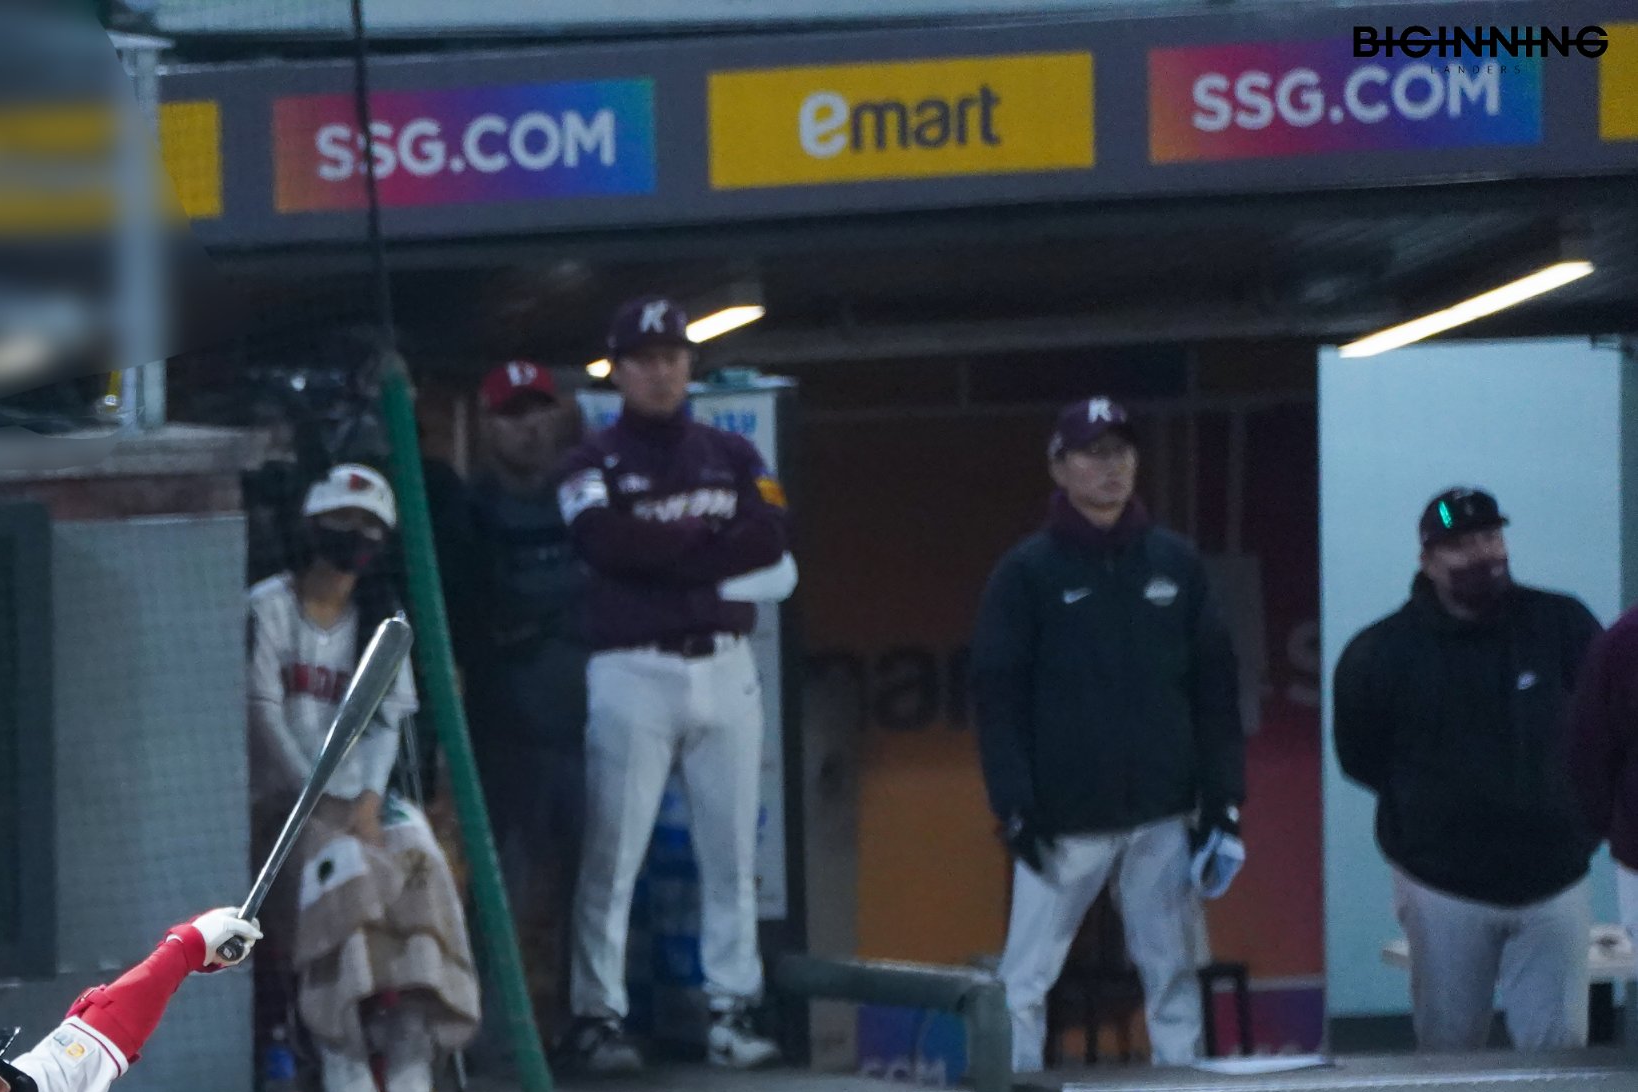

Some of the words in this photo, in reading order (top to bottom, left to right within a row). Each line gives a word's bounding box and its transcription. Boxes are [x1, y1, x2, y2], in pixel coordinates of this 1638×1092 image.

[798, 83, 1002, 160] emart
[1192, 60, 1502, 132] SSG.COM
[315, 108, 617, 182] SSG.COM
